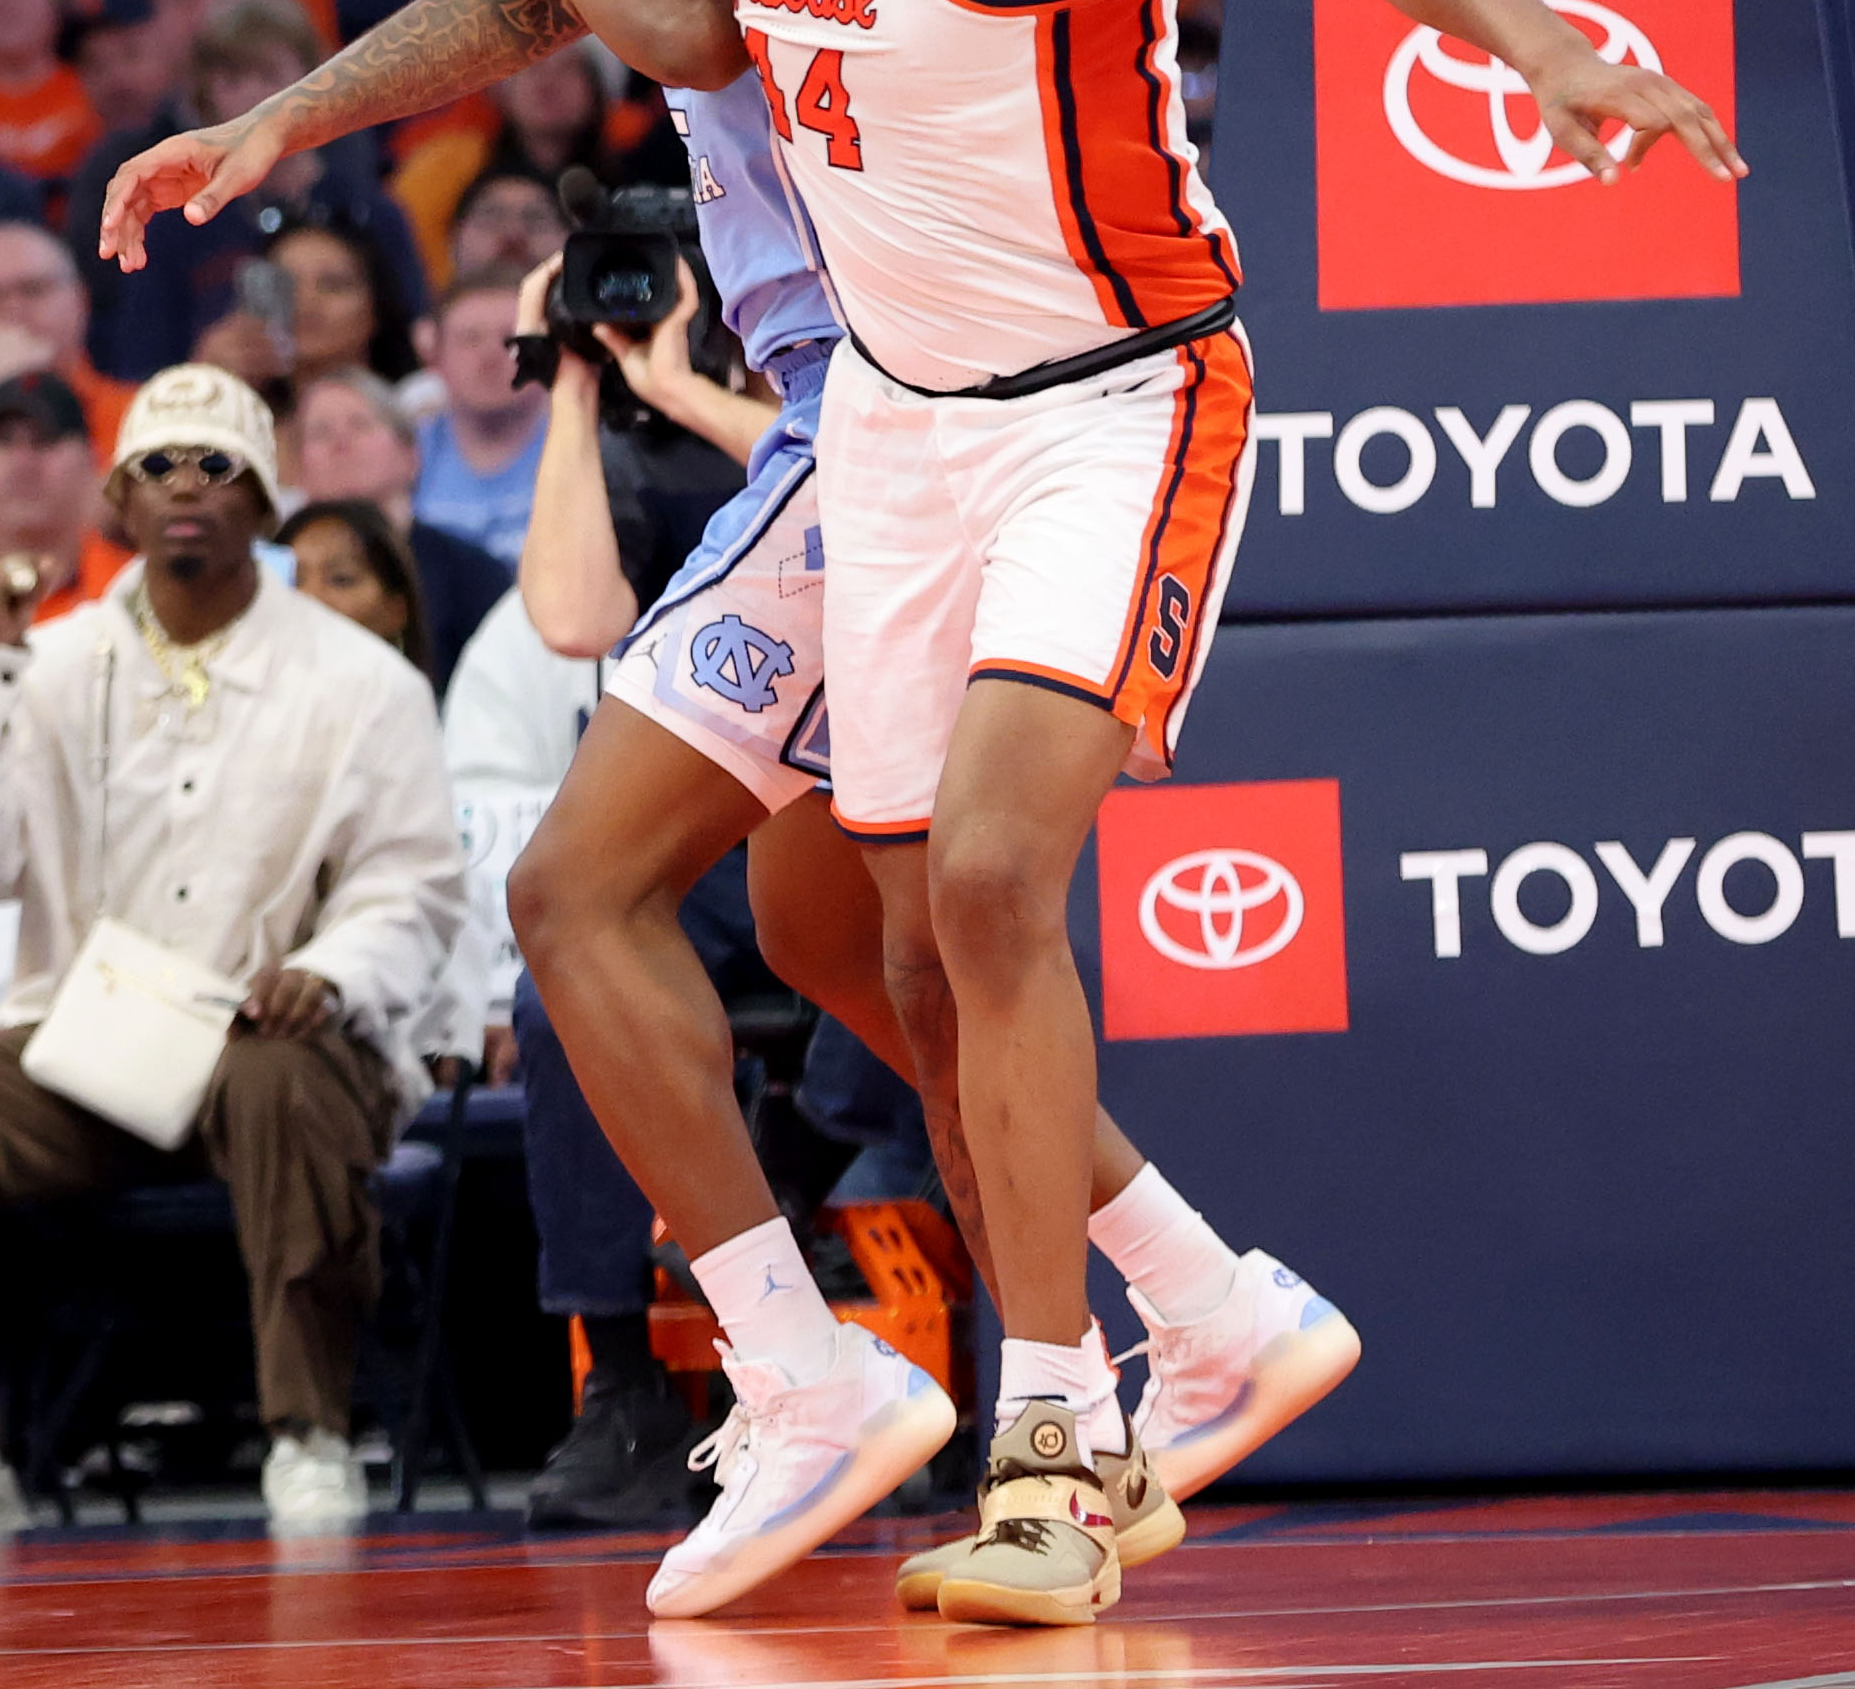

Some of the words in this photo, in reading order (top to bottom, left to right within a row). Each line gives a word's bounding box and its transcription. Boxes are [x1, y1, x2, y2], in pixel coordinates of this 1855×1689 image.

[1255, 396, 1817, 516] TOYOTA
[1147, 571, 1192, 682] S
[1399, 829, 1855, 960] TOYOT
